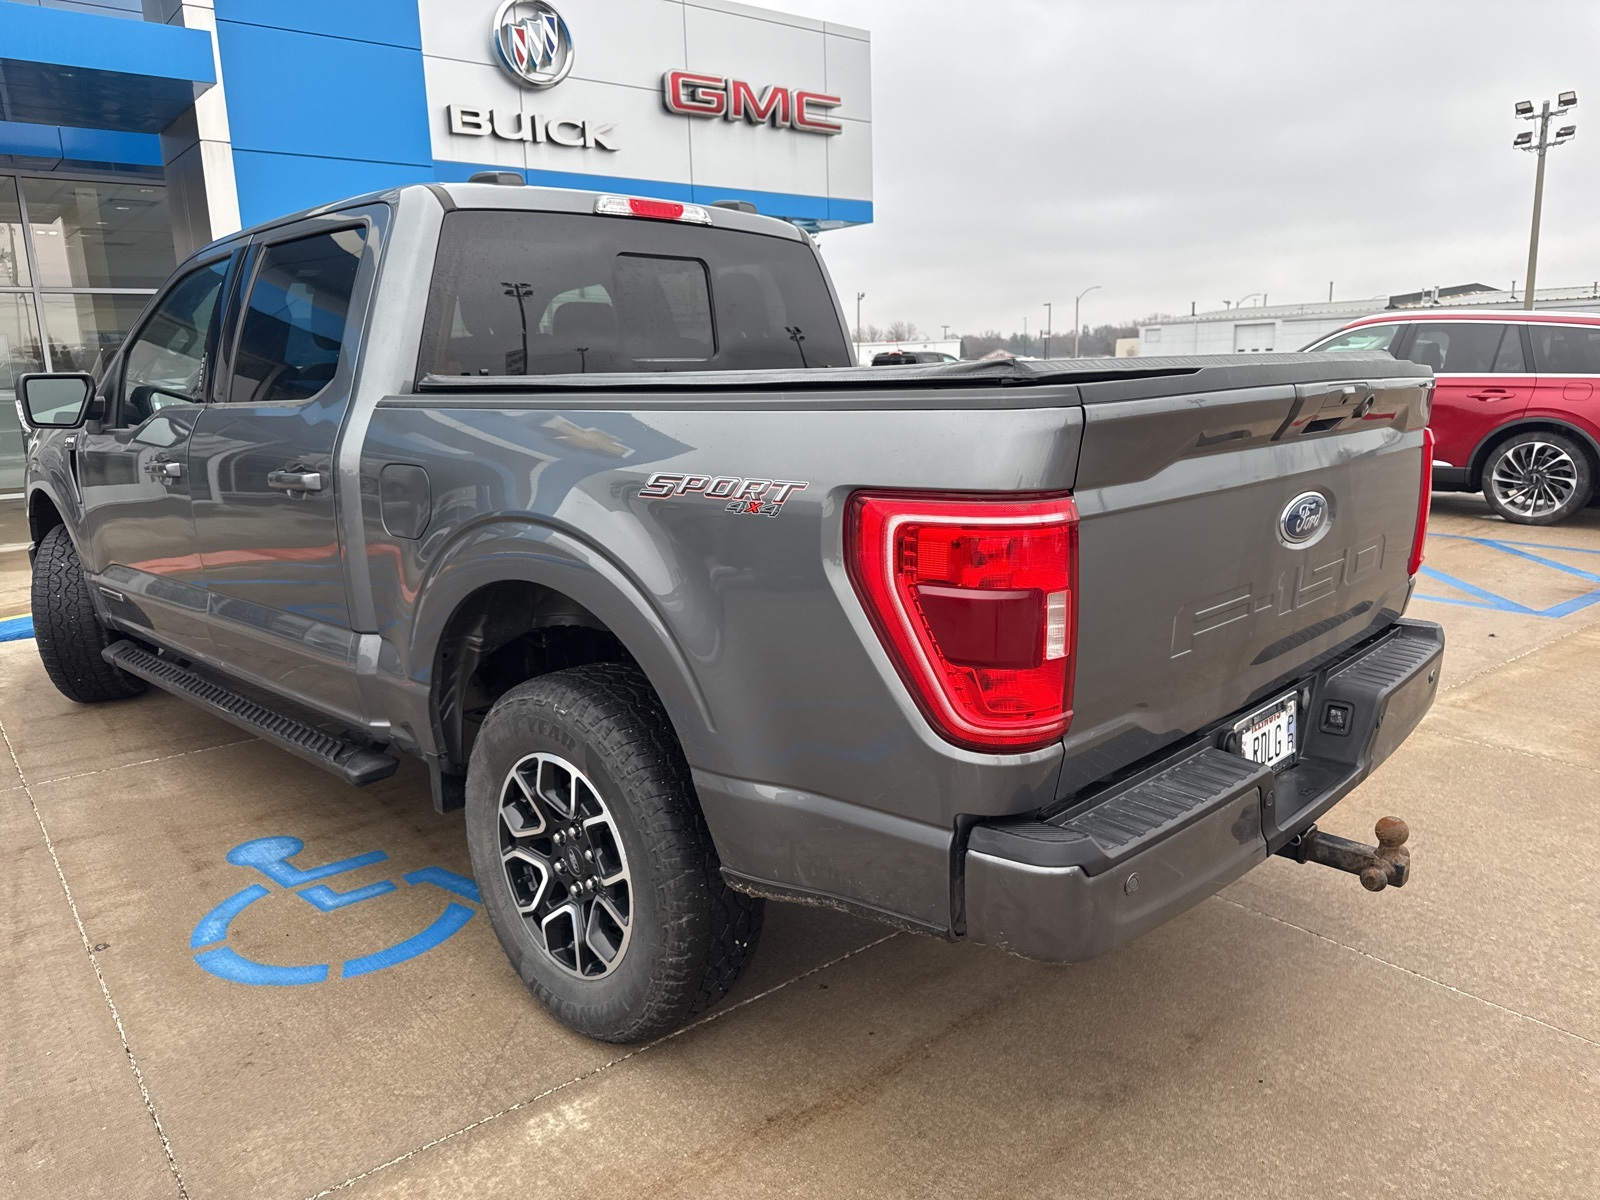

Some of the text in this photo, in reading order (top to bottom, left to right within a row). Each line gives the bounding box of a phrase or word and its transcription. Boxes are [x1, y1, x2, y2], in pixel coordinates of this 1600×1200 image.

[663, 69, 842, 135] GMC
[446, 103, 620, 151] BUICK
[638, 472, 809, 504] SPORT
[1295, 502, 1322, 533] Ford
